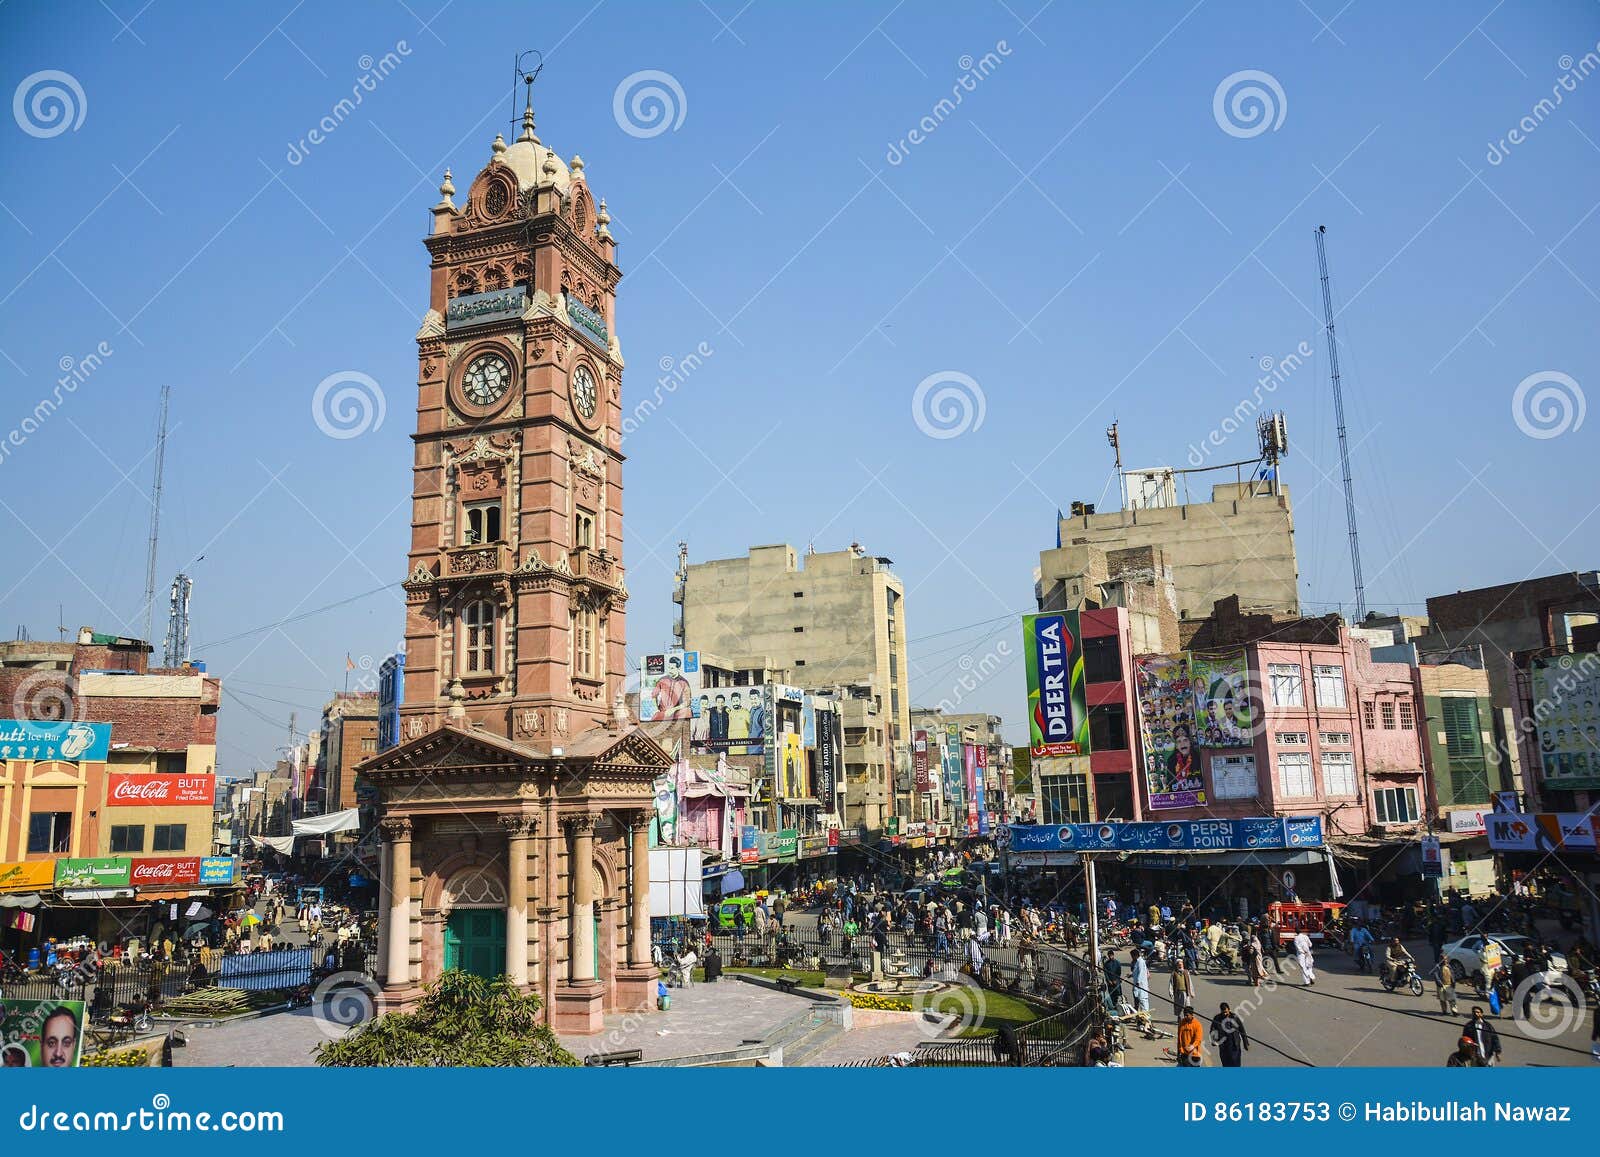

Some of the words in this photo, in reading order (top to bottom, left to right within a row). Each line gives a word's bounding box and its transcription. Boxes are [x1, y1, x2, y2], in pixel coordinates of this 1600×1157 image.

[1041, 622, 1062, 671] TEA
[1045, 669, 1067, 735] DEER
[0, 725, 25, 742] utt
[44, 733, 60, 741] Bar
[178, 778, 208, 788] BUTT
[1190, 823, 1233, 836] PEPSI
[1193, 836, 1233, 847] POINT
[1258, 836, 1282, 844] pepsi
[1300, 834, 1319, 843] pepsi
[177, 862, 196, 870] BUTT
